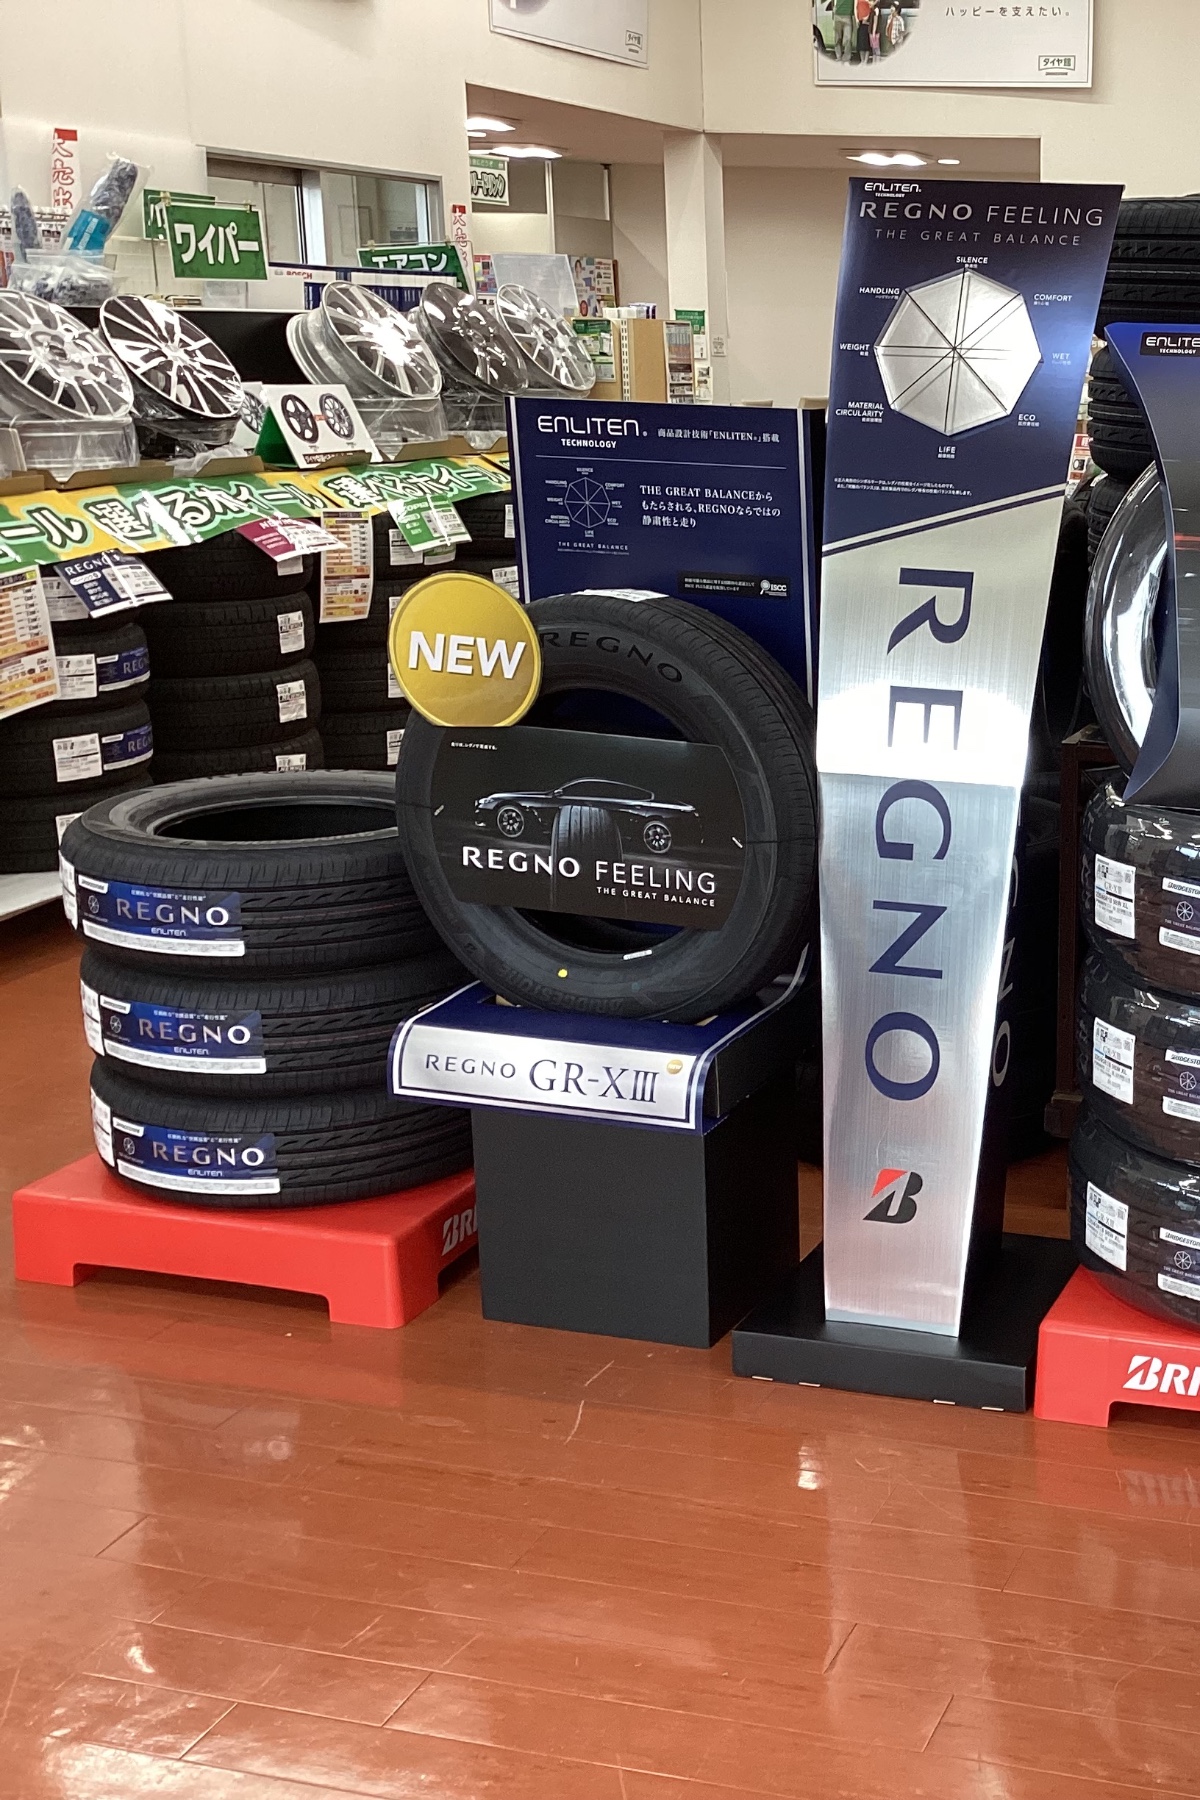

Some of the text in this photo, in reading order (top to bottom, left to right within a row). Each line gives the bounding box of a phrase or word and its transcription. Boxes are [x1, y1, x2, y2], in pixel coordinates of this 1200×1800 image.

[945, 6, 1071, 18] ハッピーを支えたい。
[1042, 58, 1072, 68] タイヤ館
[859, 202, 1103, 226] REGNO FEELING
[174, 221, 260, 264] ワイパー
[875, 229, 1081, 246] THE GREAT BALANCE
[371, 253, 447, 271] エアコン
[956, 256, 988, 264] SILENCE
[859, 287, 900, 295] HANDLING
[1034, 294, 1072, 302] COMFORT
[836, 409, 884, 417] CIRCULARITY
[561, 439, 617, 448] TECHNOLOGY
[938, 446, 955, 454] LIFE
[640, 485, 772, 501] THE GREAT BALANCEから
[642, 500, 780, 517] もたらされる、REGNOならではの
[642, 515, 696, 528] 静粛性と走り
[408, 631, 526, 679] NEW
[538, 631, 682, 683] REGNO
[865, 566, 975, 1101] REGNO
[463, 846, 716, 894] REGNO FEELING
[597, 887, 715, 907] THE GREAT BALANCE
[116, 898, 229, 926] REGNO
[151, 927, 186, 937] ENLITEN
[139, 1018, 250, 1045] REGNO
[174, 1046, 209, 1056] ENLITEN
[425, 1054, 516, 1079] REGNO
[152, 1141, 264, 1167] REGNO
[187, 1168, 223, 1177] ENLITEN
